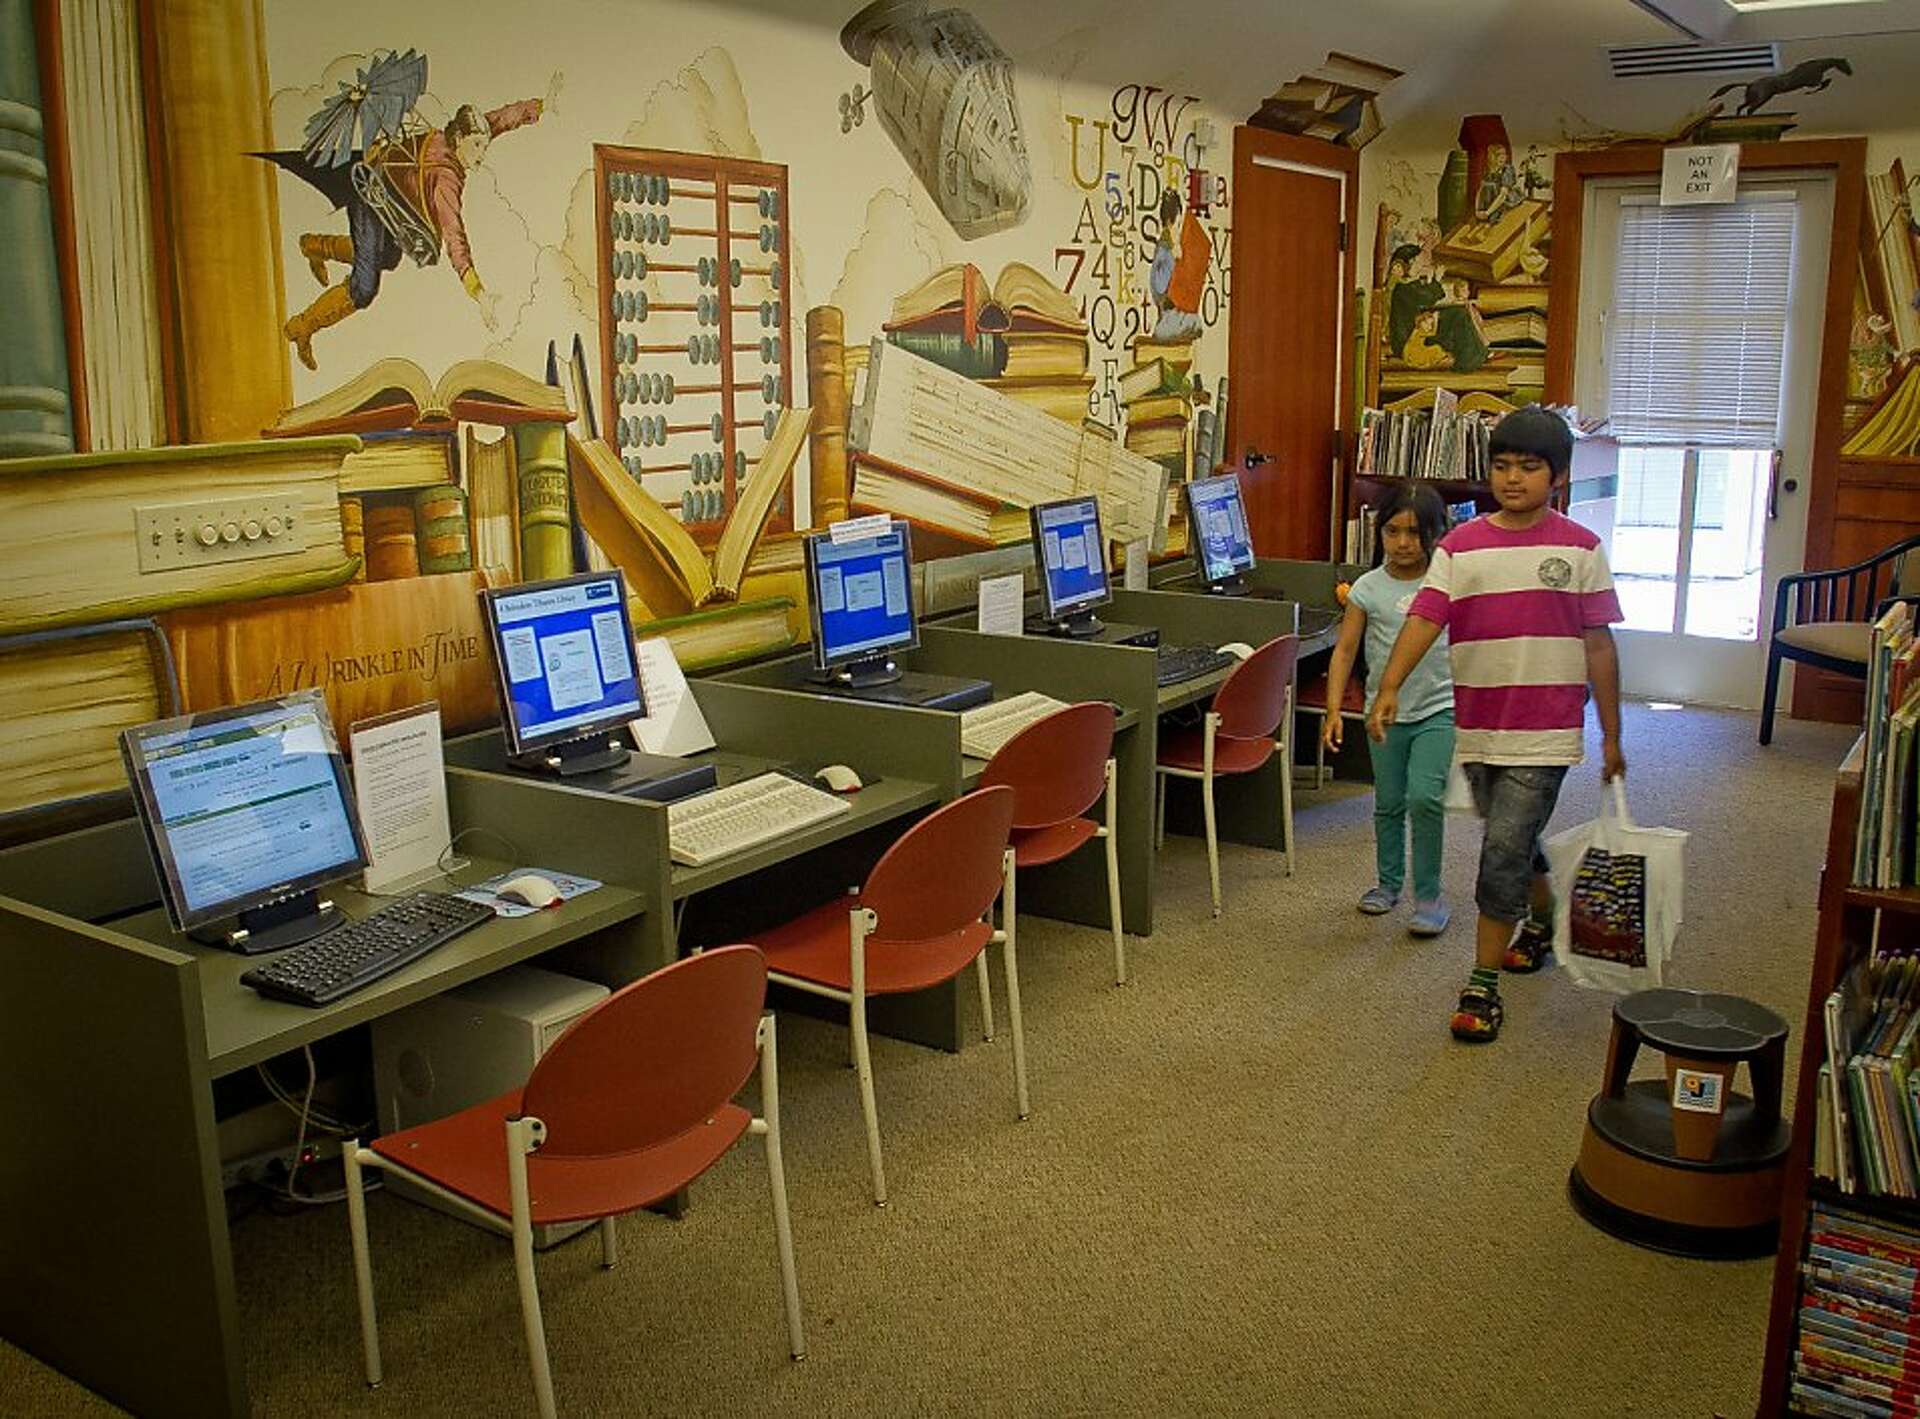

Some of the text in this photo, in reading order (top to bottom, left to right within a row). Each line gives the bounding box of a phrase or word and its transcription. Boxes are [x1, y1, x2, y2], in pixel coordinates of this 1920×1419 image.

[1065, 114, 1109, 190] U
[1688, 156, 1714, 167] NOT
[1691, 170, 1708, 179] AN
[1136, 162, 1160, 211] D
[1686, 183, 1711, 193] EXIT
[1071, 197, 1103, 243] A
[1055, 248, 1086, 295] 7
[1091, 244, 1111, 290] 4
[1091, 295, 1115, 350] Q
[407, 647, 426, 671] IN
